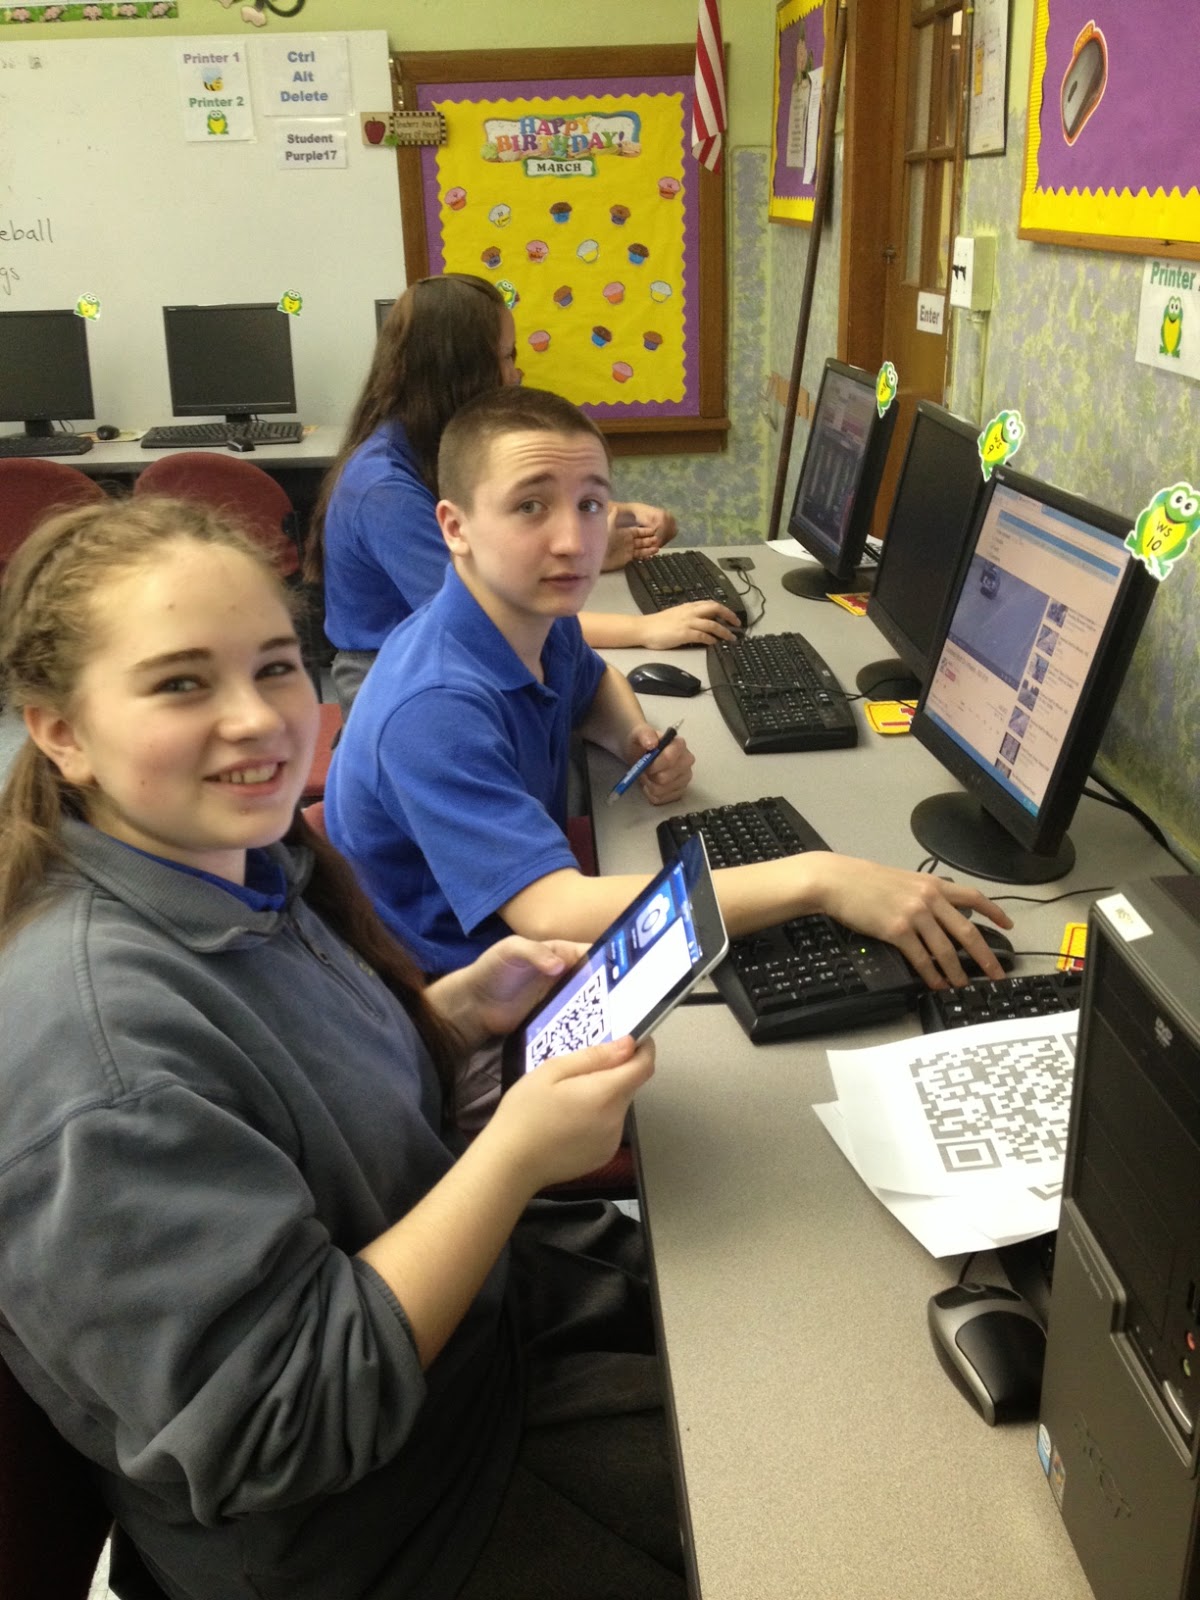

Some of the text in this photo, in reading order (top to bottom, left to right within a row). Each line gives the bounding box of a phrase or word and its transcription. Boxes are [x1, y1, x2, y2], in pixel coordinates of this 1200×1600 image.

[183, 52, 240, 64] Printer 1
[287, 51, 315, 63] Ctrl
[292, 71, 314, 82] Alt
[189, 97, 245, 108] Printer 2
[280, 91, 329, 102] Delete
[520, 115, 592, 136] HAPPY
[287, 134, 334, 144] Student
[495, 131, 625, 153] BIRTHDAY!
[285, 150, 338, 163] Purple17
[536, 163, 582, 173] MARCH
[1150, 261, 1197, 290] Printer
[920, 304, 940, 325] Enter
[1156, 520, 1173, 538] WS
